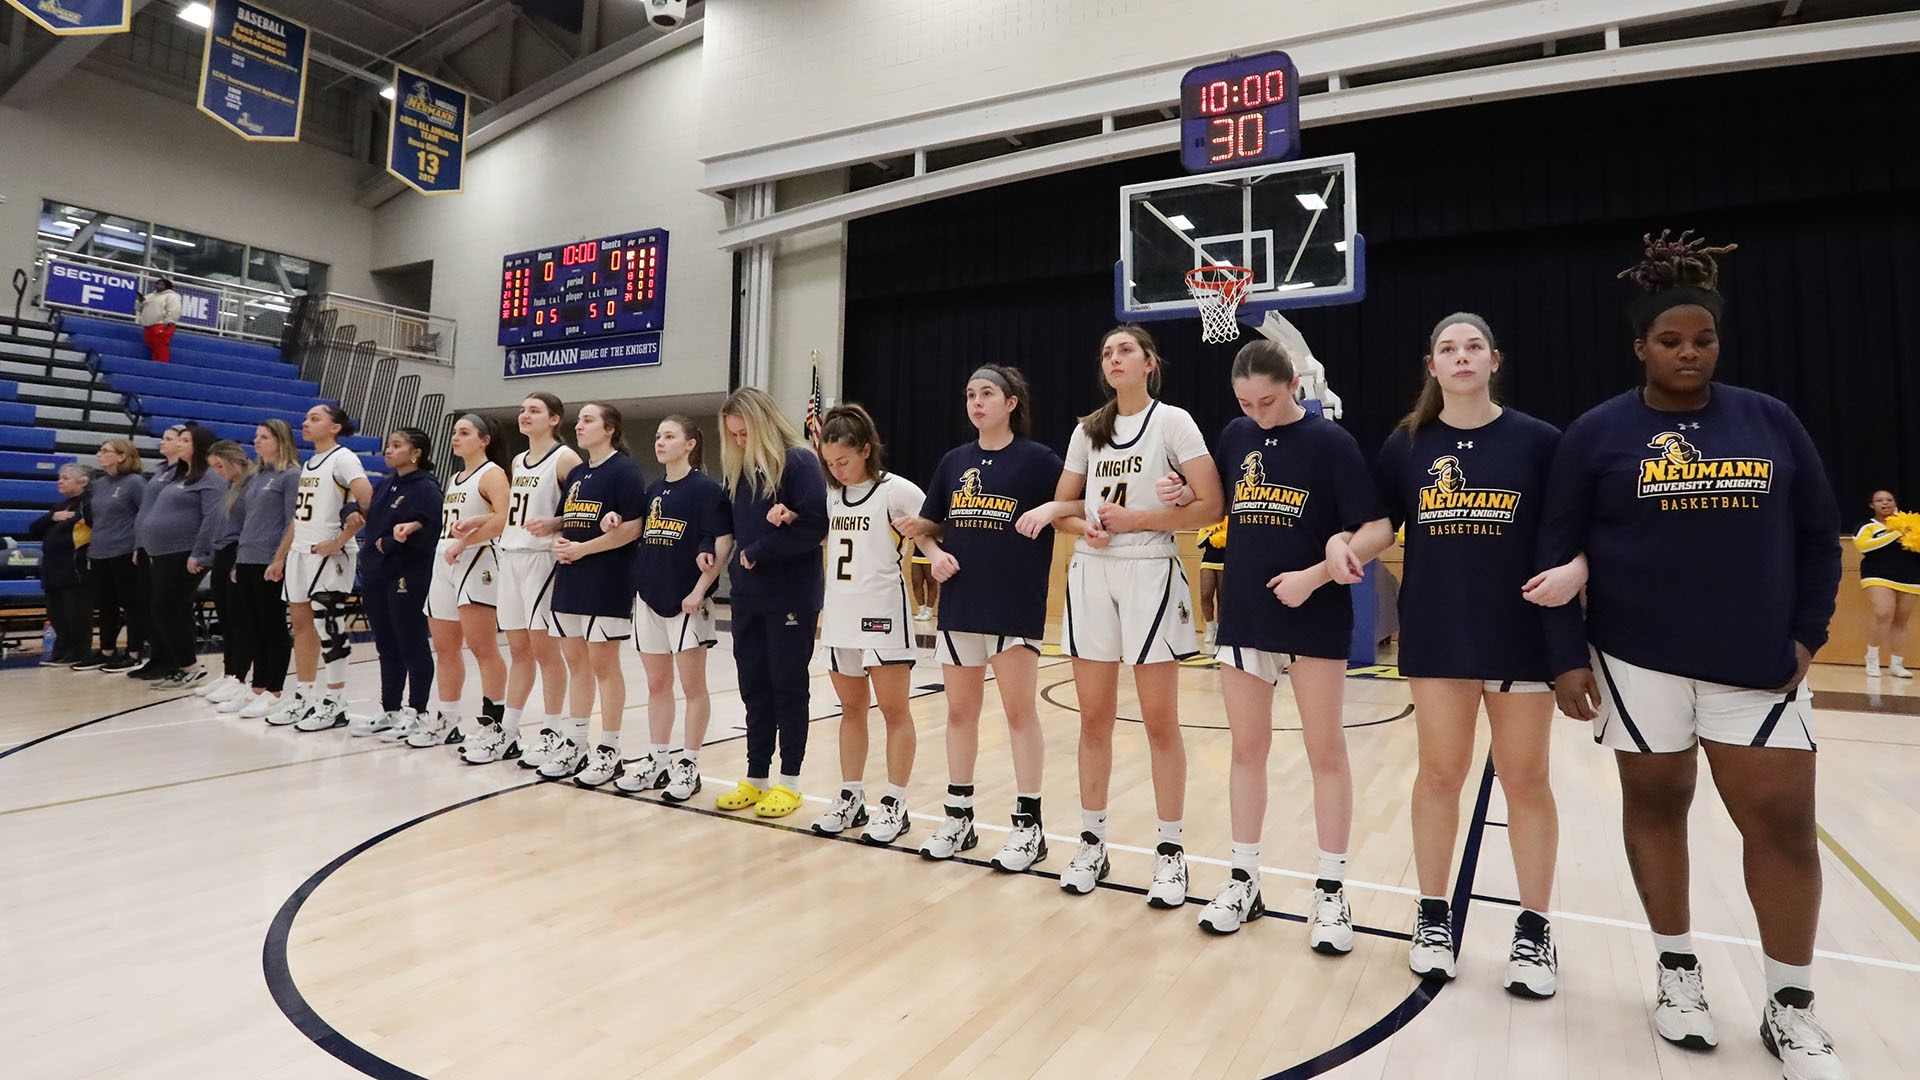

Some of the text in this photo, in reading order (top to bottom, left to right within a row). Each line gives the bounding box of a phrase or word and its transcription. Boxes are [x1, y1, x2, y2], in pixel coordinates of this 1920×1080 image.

[237, 6, 286, 38] BASEBALL
[1201, 69, 1284, 113] 10:00
[408, 96, 455, 122] NEUMANN
[418, 121, 430, 132] ALL
[421, 130, 439, 143] TEAM
[1211, 112, 1263, 162] 30
[417, 151, 440, 175] 13
[563, 241, 598, 266] 10:00
[610, 250, 621, 271] 0
[53, 265, 135, 290] SECTION
[544, 261, 555, 282] 0
[592, 271, 597, 285] 1
[81, 284, 105, 304] F
[181, 295, 209, 320] ME
[535, 310, 545, 325] 0
[549, 308, 558, 324] 5
[589, 302, 598, 318] 5
[606, 300, 615, 316] 0
[521, 342, 657, 369] NEUMANN HOME OF THE KNIGHTS
[1643, 460, 1769, 482] NEUMANN
[1236, 483, 1305, 506] NEUMANN
[1643, 479, 1767, 493] UNIVERSITY KNIGHTS
[295, 492, 314, 521] 25
[509, 493, 529, 526] 21
[952, 493, 1015, 512] NEUMANN
[1267, 502, 1300, 513] KNIGHTS
[1421, 488, 1516, 510] NEUMANN
[1661, 496, 1759, 511] BASKETBALL
[831, 516, 870, 531] KNIGHTS
[955, 520, 1003, 530] BASKETBALL
[1420, 509, 1511, 520] UNIVERSITY KNIGHTS
[1429, 523, 1502, 535] BASKETBALL
[837, 538, 853, 580] 2
